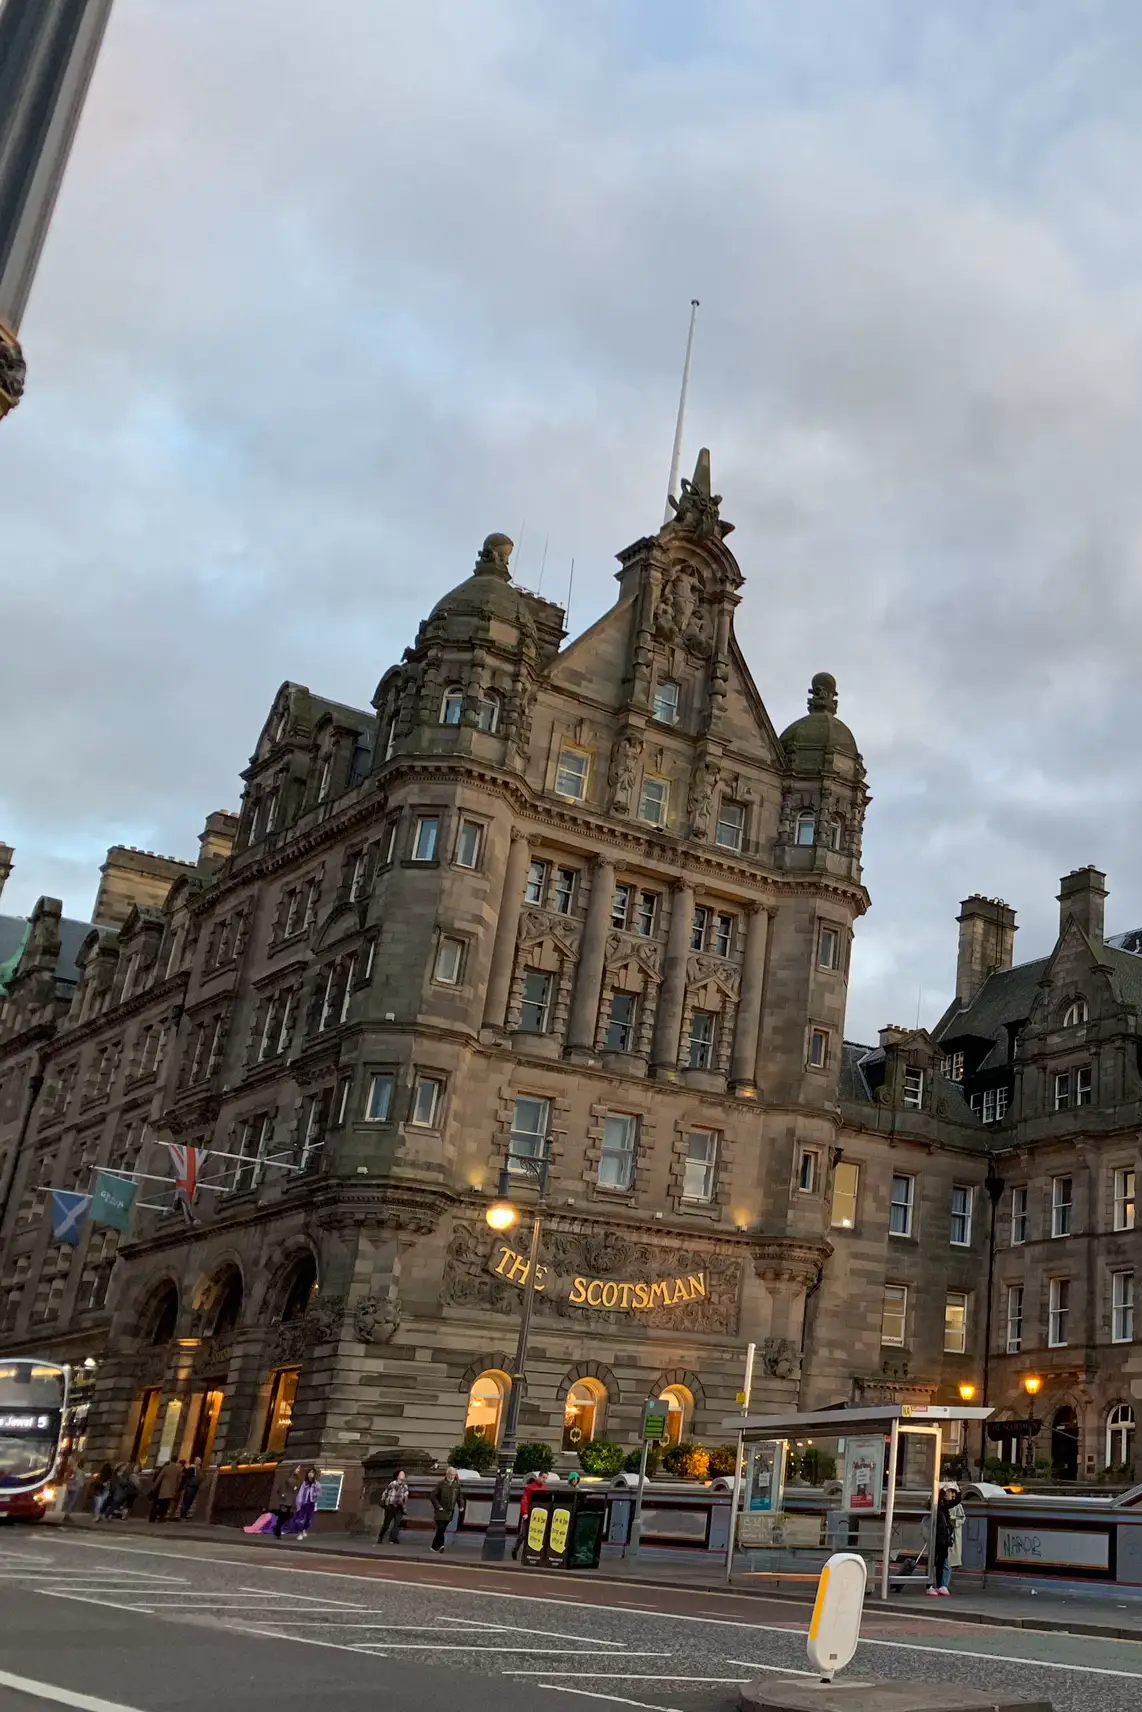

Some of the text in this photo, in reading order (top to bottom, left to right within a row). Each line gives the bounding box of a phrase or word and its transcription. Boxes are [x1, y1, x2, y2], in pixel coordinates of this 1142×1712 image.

[494, 1247, 706, 1309] THE SCOTSMAN
[37, 1416, 48, 1429] 5
